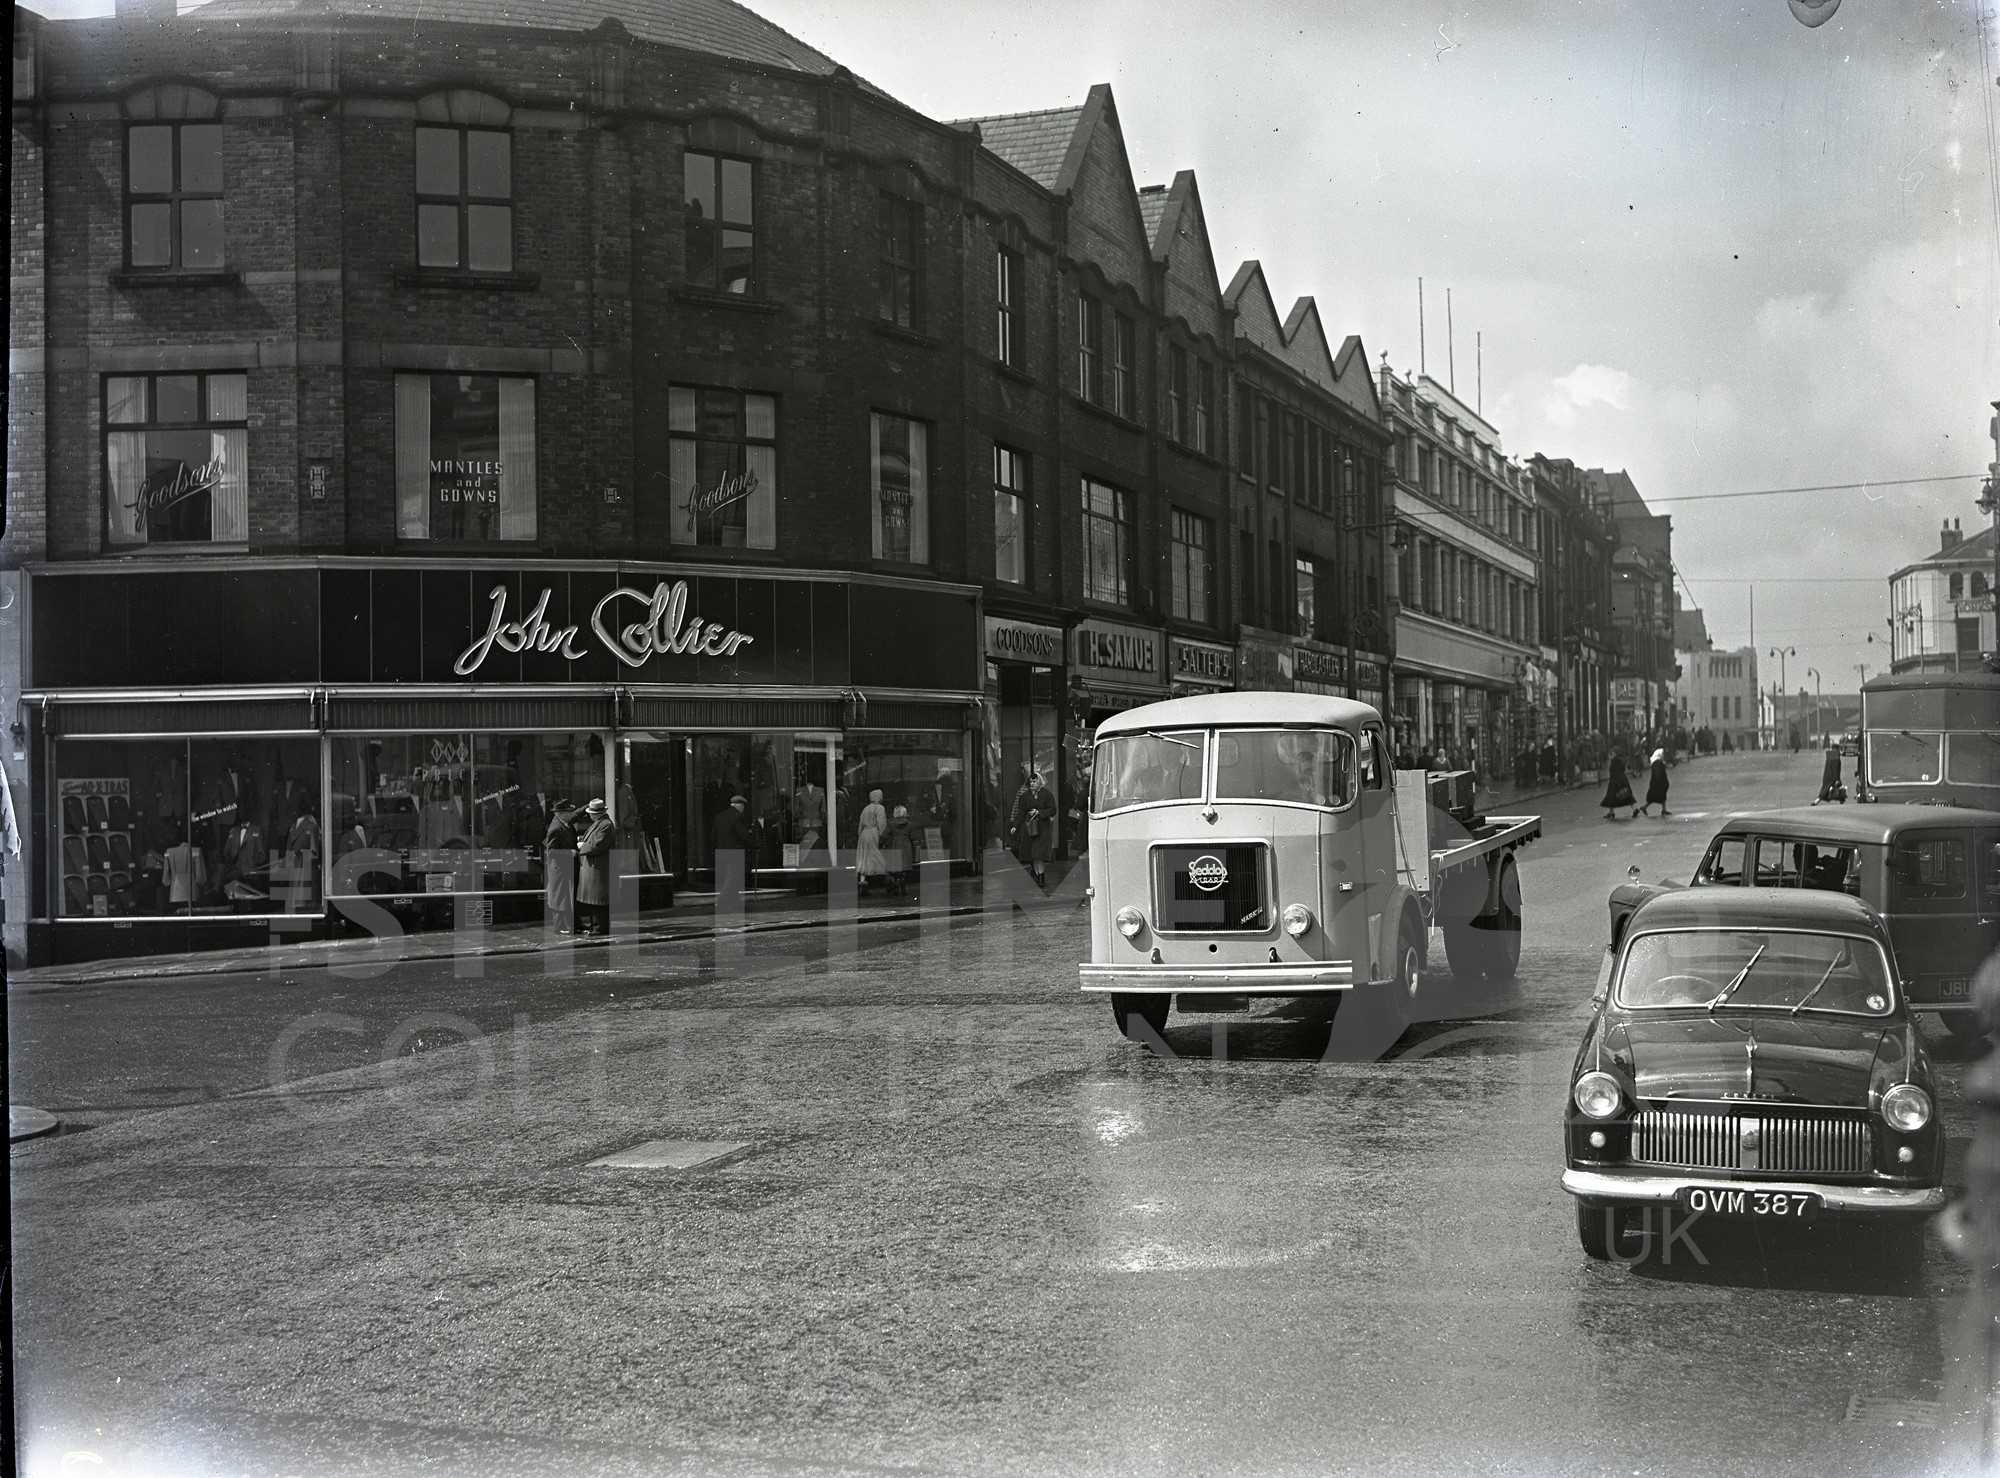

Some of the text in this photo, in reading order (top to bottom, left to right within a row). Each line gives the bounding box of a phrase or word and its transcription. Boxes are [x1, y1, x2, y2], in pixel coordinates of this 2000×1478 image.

[430, 459, 504, 475] MANTLES
[456, 476, 481, 488] and
[123, 455, 224, 533] Goodsons
[440, 488, 497, 504] GOWNS
[453, 579, 754, 675] John Collier
[996, 626, 1057, 656] GOODSONS
[1089, 629, 1158, 673] H. SAMUEL
[1179, 646, 1231, 678] SALTER'S
[1690, 1189, 1809, 1217] OVM 387
